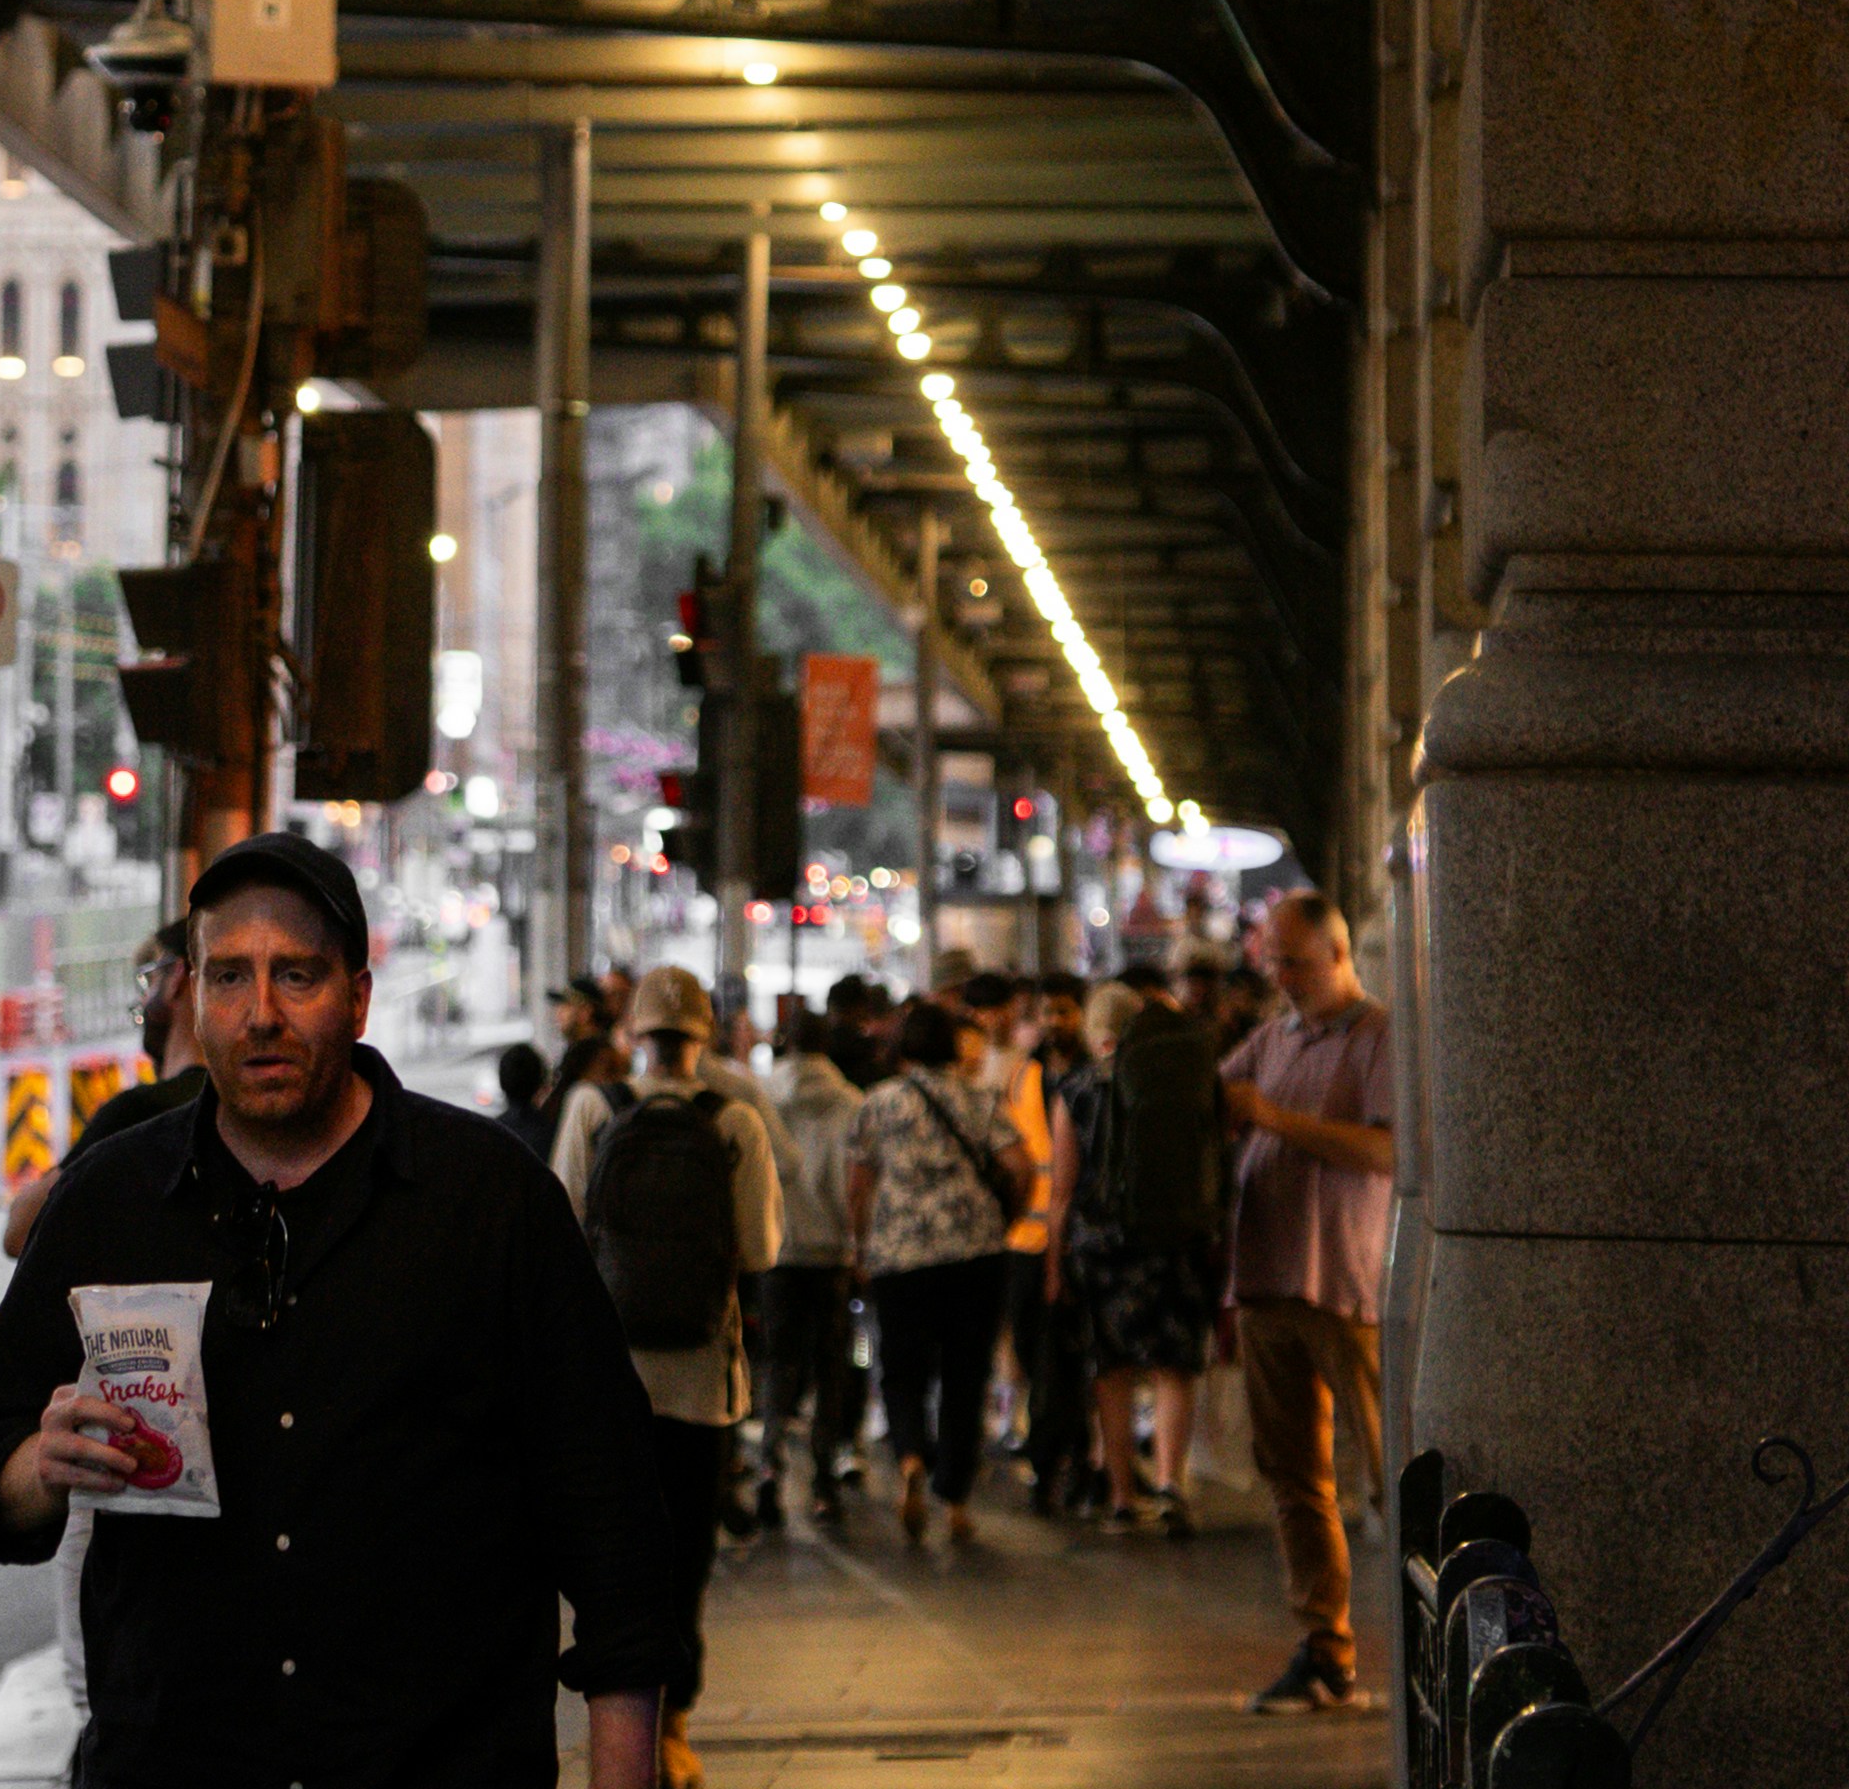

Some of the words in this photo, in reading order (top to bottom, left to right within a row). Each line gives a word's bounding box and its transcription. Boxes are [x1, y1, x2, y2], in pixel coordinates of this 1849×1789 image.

[83, 1332, 108, 1359] THE
[109, 1328, 173, 1352] NATURAL
[98, 1375, 185, 1406] Snakes
